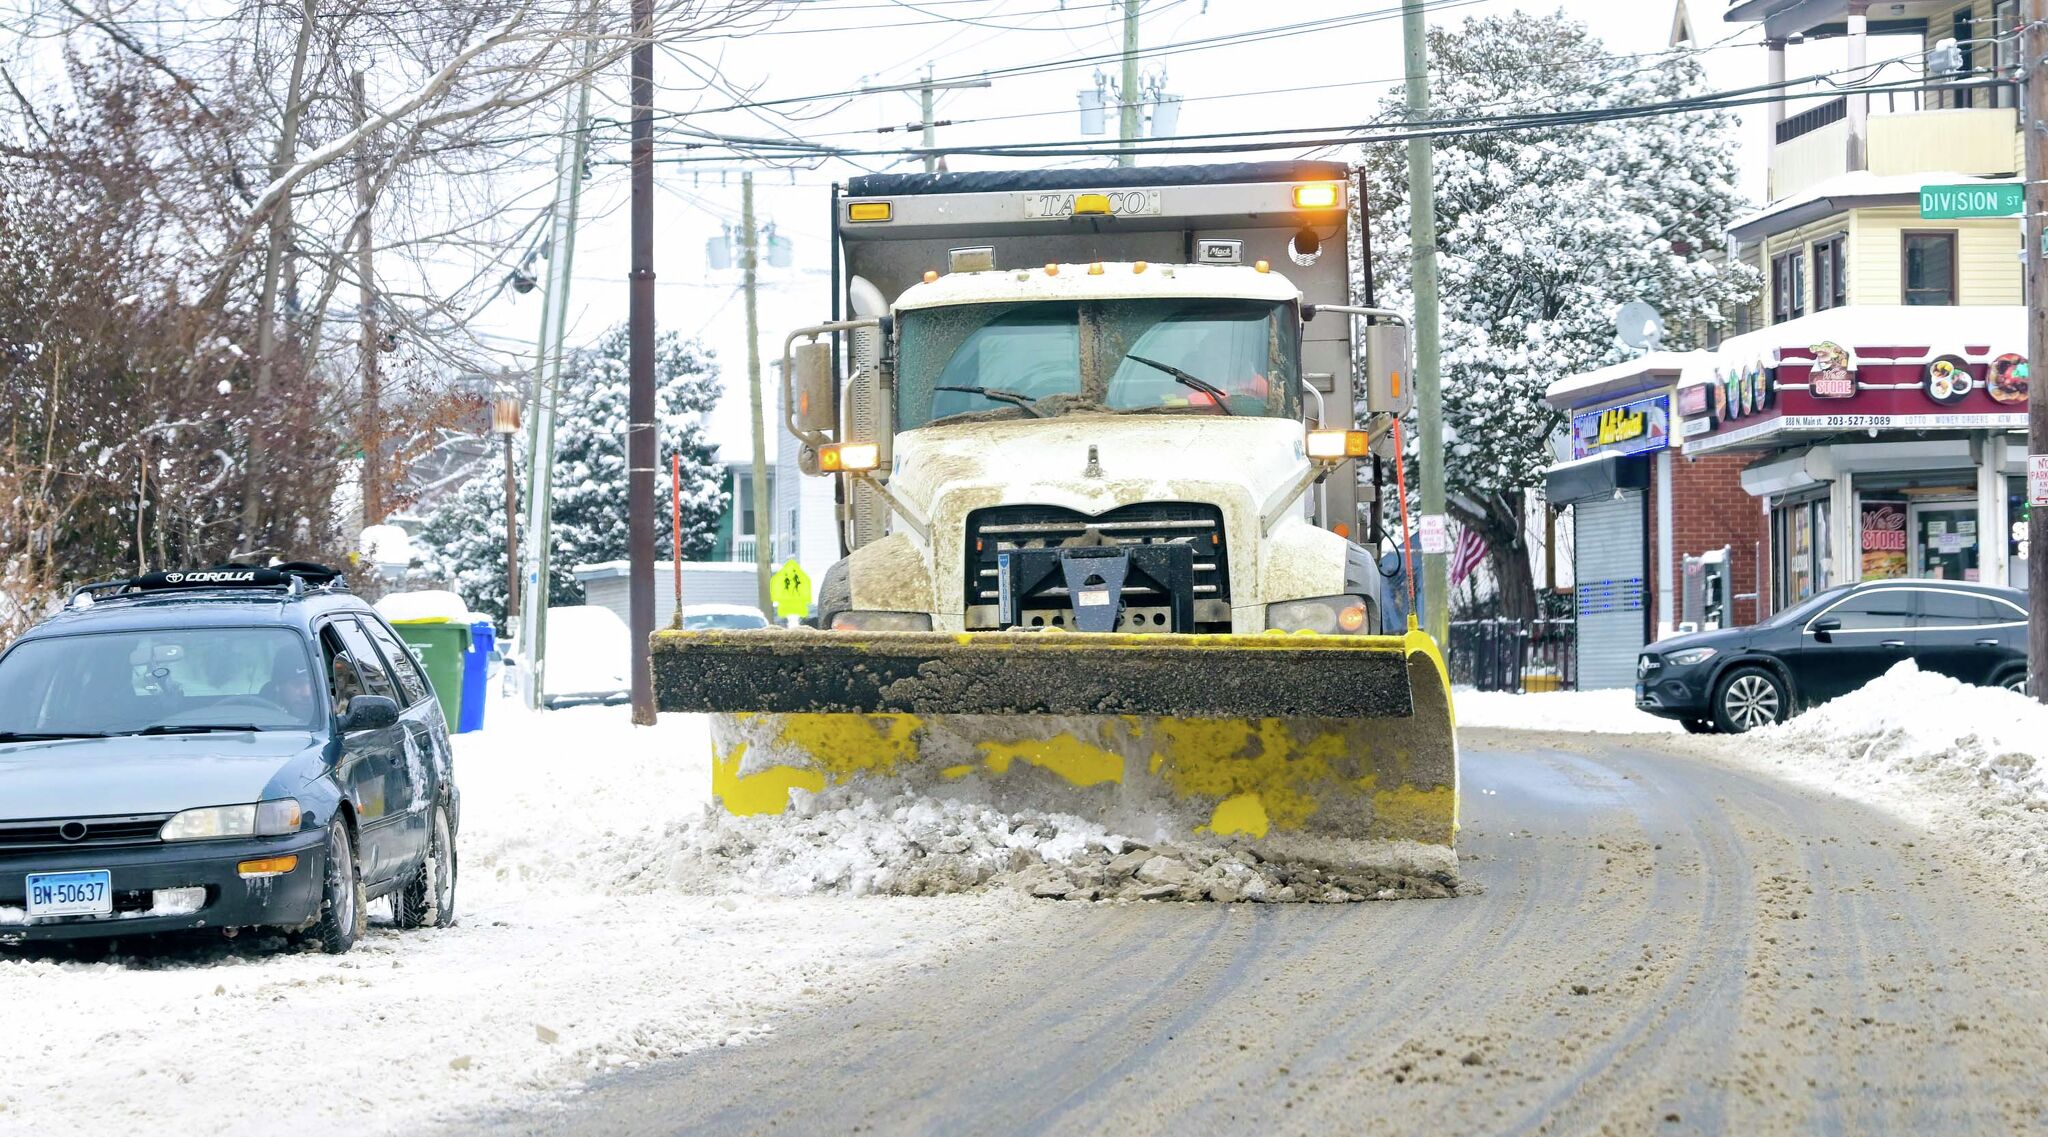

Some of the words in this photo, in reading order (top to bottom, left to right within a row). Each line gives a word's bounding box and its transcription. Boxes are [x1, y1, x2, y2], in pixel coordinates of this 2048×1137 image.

[1039, 191, 1146, 217] TACO
[1922, 191, 1998, 212] DIVISION
[2006, 195, 2019, 206] ST
[1815, 379, 1852, 394] STORE
[1862, 530, 1906, 550] STORE
[185, 571, 255, 582] COROLLA
